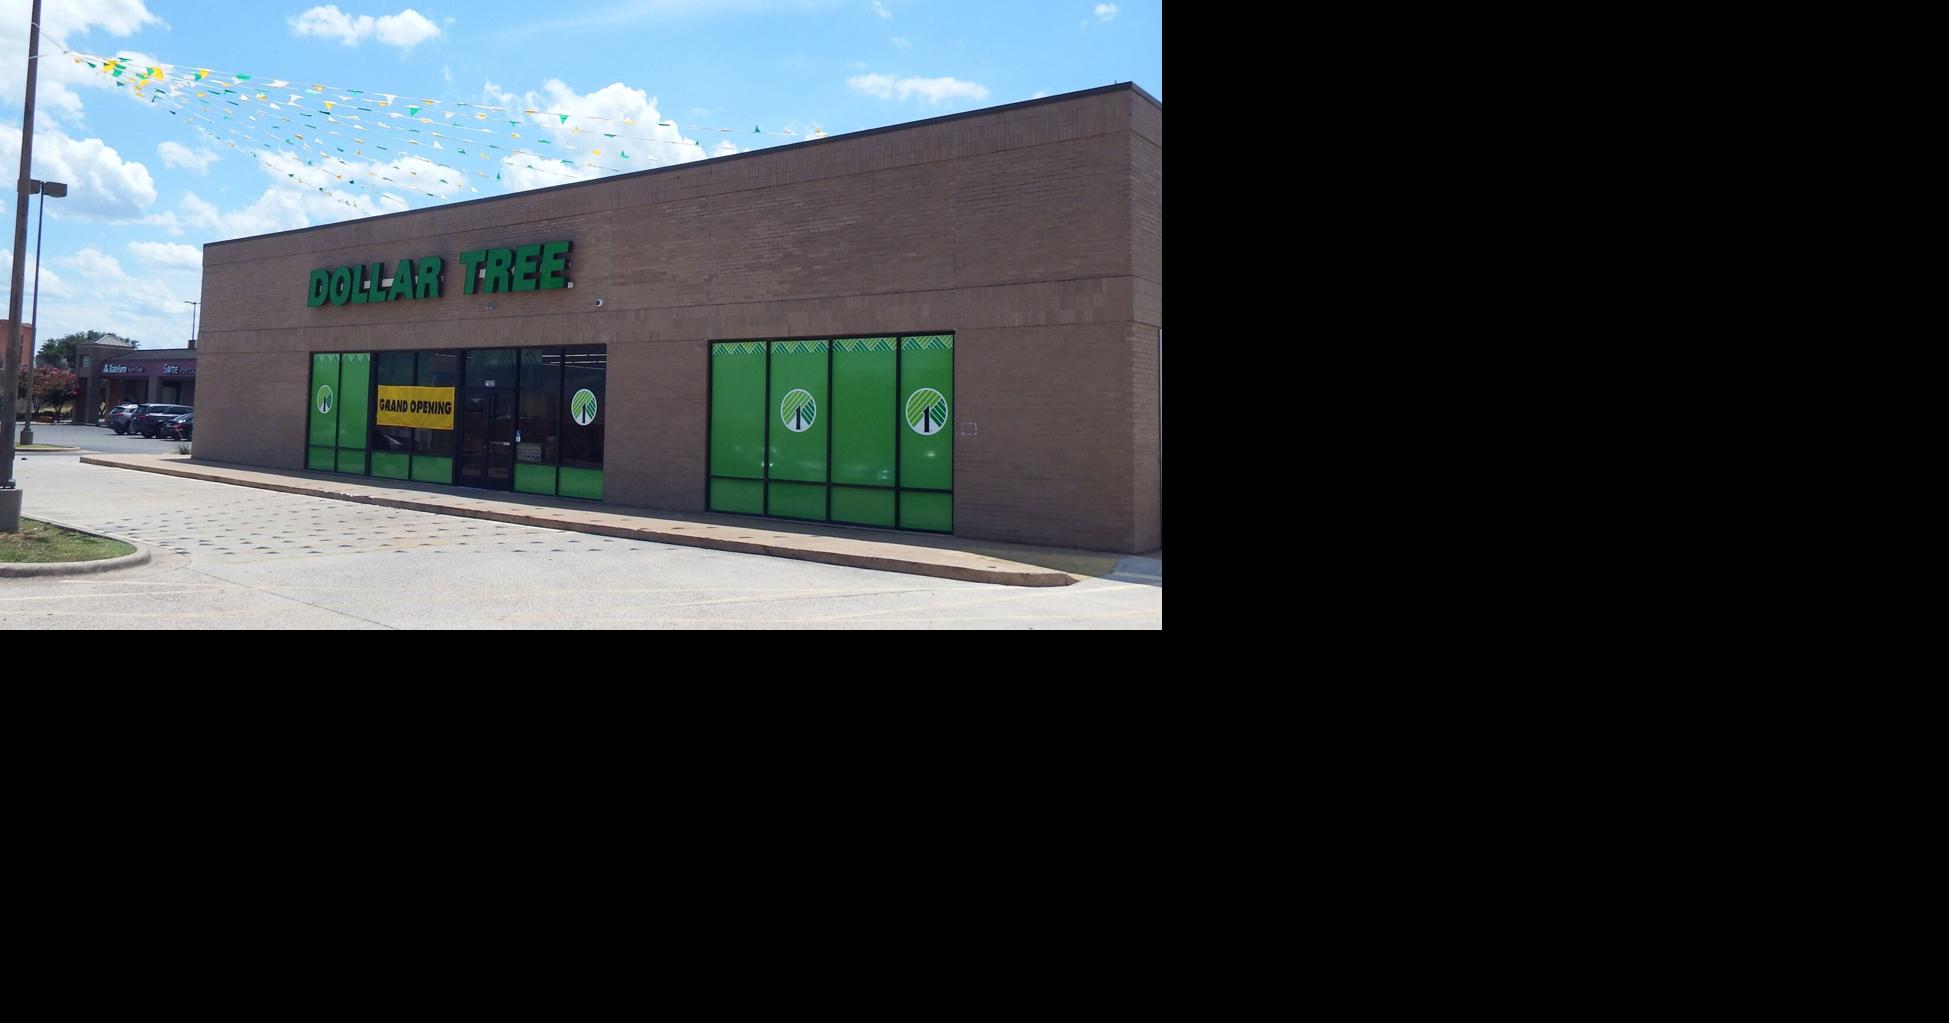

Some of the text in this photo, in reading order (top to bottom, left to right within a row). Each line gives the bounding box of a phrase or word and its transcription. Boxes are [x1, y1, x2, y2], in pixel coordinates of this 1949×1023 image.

[307, 240, 571, 308] DOLLAR TREE
[380, 398, 452, 415] GRAND OPENING
